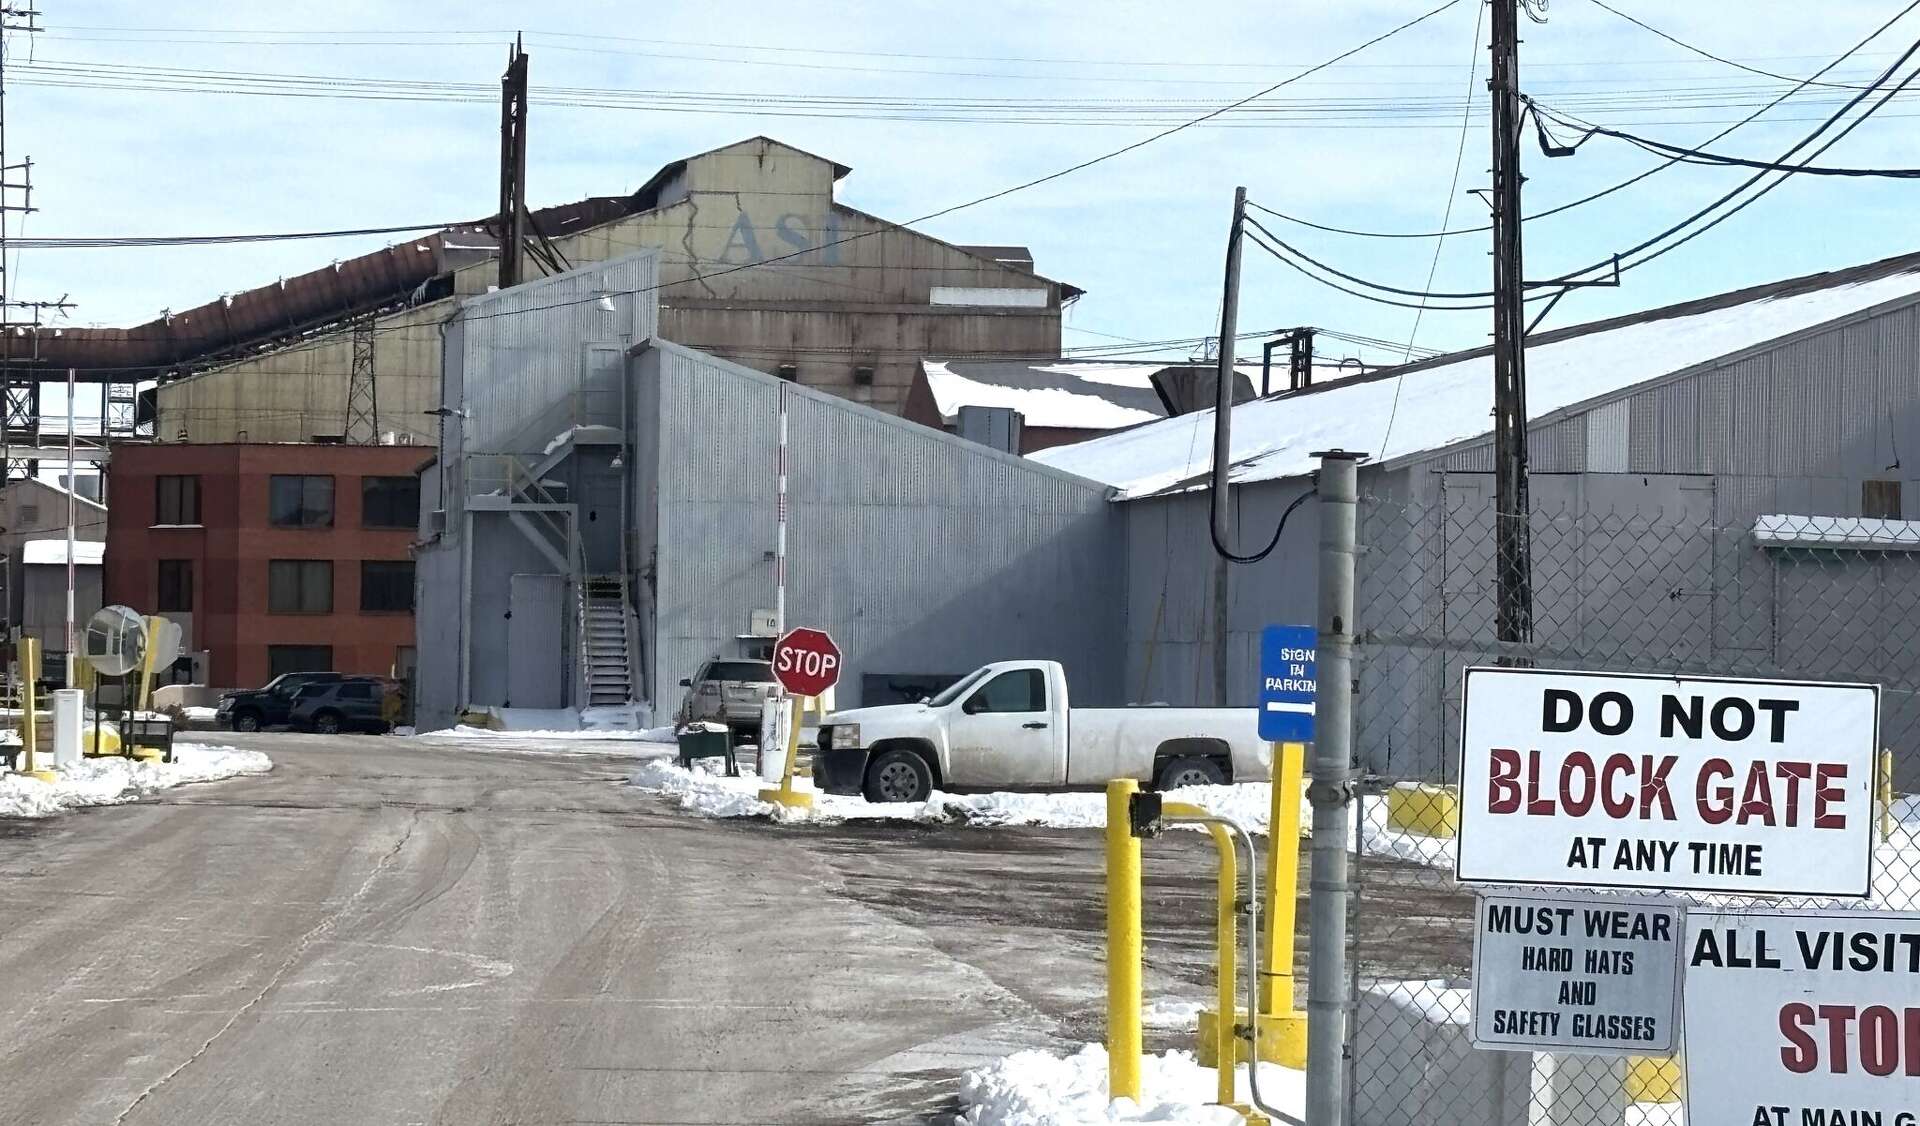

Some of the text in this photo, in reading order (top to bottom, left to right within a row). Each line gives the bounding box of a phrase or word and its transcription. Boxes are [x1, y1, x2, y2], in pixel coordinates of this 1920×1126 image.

[778, 646, 836, 678] STOP
[1281, 648, 1315, 662] SIGN
[1290, 664, 1305, 677] IN
[1542, 688, 1799, 743] DO NOT
[1488, 748, 1848, 829] BLOCK GATE
[1567, 837, 1762, 876] AT ANY TIME
[1488, 905, 1671, 941] MUST WEAR
[1522, 946, 1634, 975] HARD HATS
[1691, 928, 1781, 968] ALL
[1558, 981, 1597, 1005] AND
[1493, 1010, 1656, 1041] SAFETY GLASSES
[1752, 1105, 1790, 1126] AT
